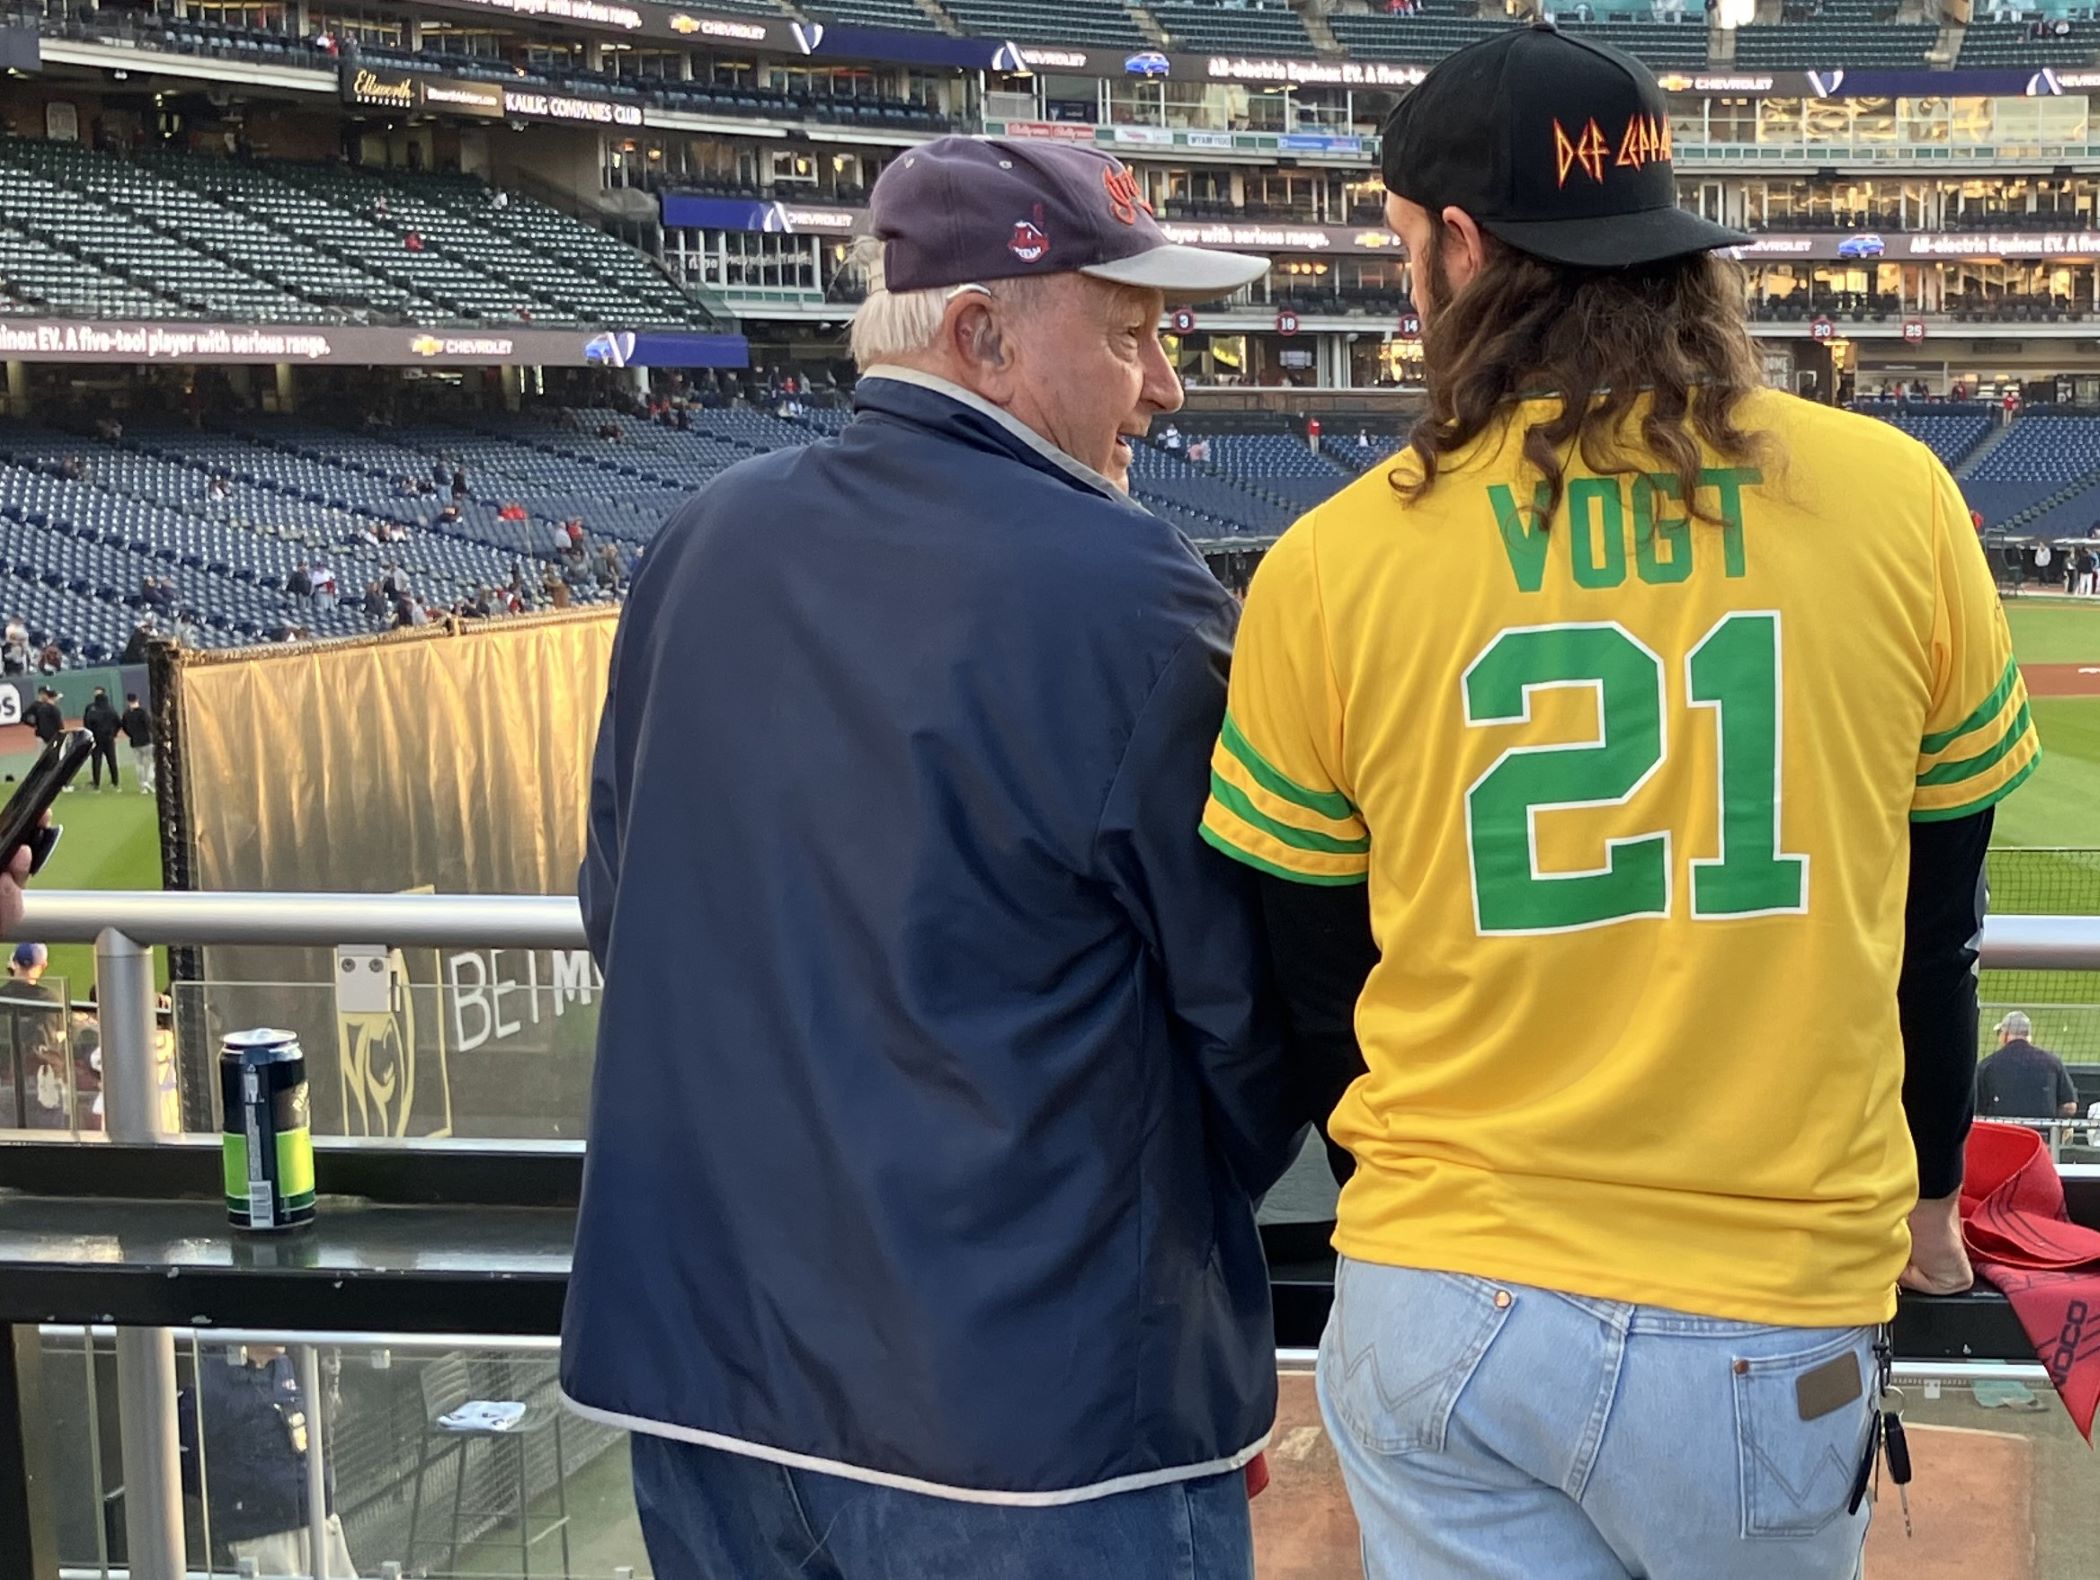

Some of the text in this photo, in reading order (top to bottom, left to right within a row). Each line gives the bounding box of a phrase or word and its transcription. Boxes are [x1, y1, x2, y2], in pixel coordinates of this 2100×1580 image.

[701, 21, 766, 40] CHEVROLET
[1208, 56, 1286, 80] All-electric
[1287, 62, 1341, 83] Equinox
[1342, 64, 1363, 83] EV.
[1364, 64, 1377, 84] A
[354, 69, 412, 98] Ellsworth
[1695, 77, 1773, 90] CHEVROLET
[505, 93, 642, 126] KAULIG COMPANIES CLUB
[1553, 117, 1611, 190] DEF
[1161, 224, 1330, 249] layer with serious range.
[1910, 236, 1987, 253] All-electric
[1988, 235, 2042, 255] Equinox
[2044, 236, 2065, 253] EV.
[2067, 235, 2077, 253] A
[1179, 315, 1189, 328] 3
[1404, 320, 1418, 332] 14
[1814, 325, 1830, 337] 20
[1906, 324, 1922, 337] 25
[38, 326, 64, 351] EV.
[66, 327, 78, 351] A
[79, 326, 146, 352] five-tool
[149, 328, 195, 357] player
[197, 329, 230, 353] with
[232, 330, 284, 354] serious
[286, 335, 331, 358] range.
[446, 338, 513, 354] CHEVROLET
[1486, 468, 1763, 593] VOGT
[0, 697, 16, 717] S
[1461, 609, 1810, 936] 21
[450, 949, 604, 1052] BETM
